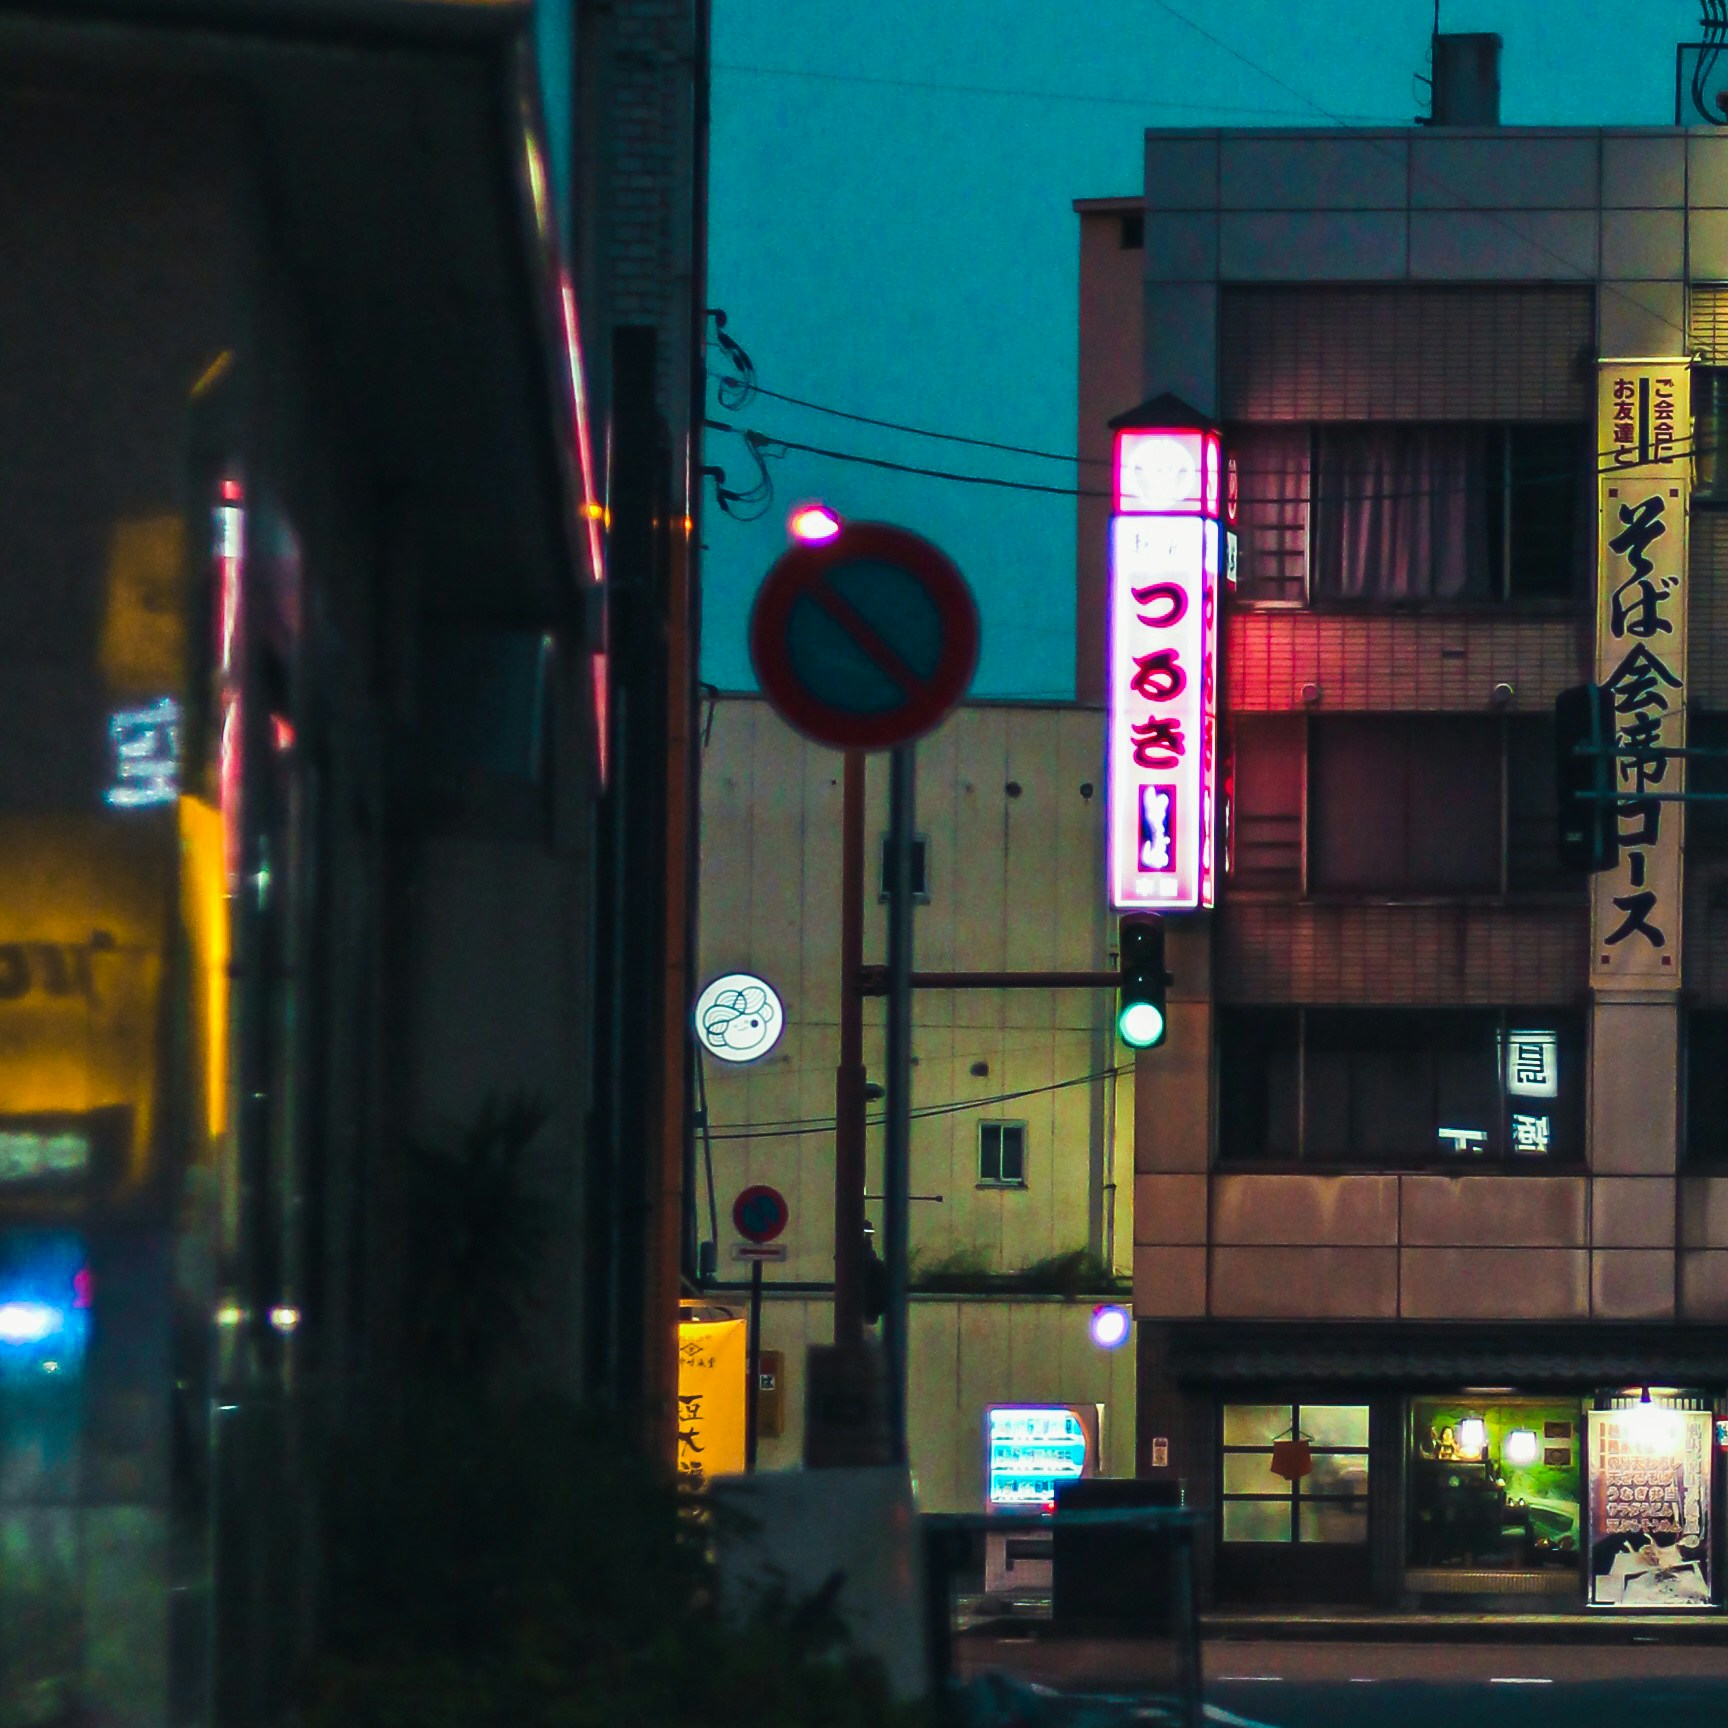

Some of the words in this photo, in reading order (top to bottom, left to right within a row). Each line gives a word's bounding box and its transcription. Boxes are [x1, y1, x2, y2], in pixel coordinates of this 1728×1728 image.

[1613, 377, 1635, 466] お友達と
[1653, 378, 1675, 464] ご会合に
[1129, 581, 1189, 770] つるき
[1603, 494, 1684, 949] そば会席コース
[1607, 1486, 1679, 1502] うなぎ弁当
